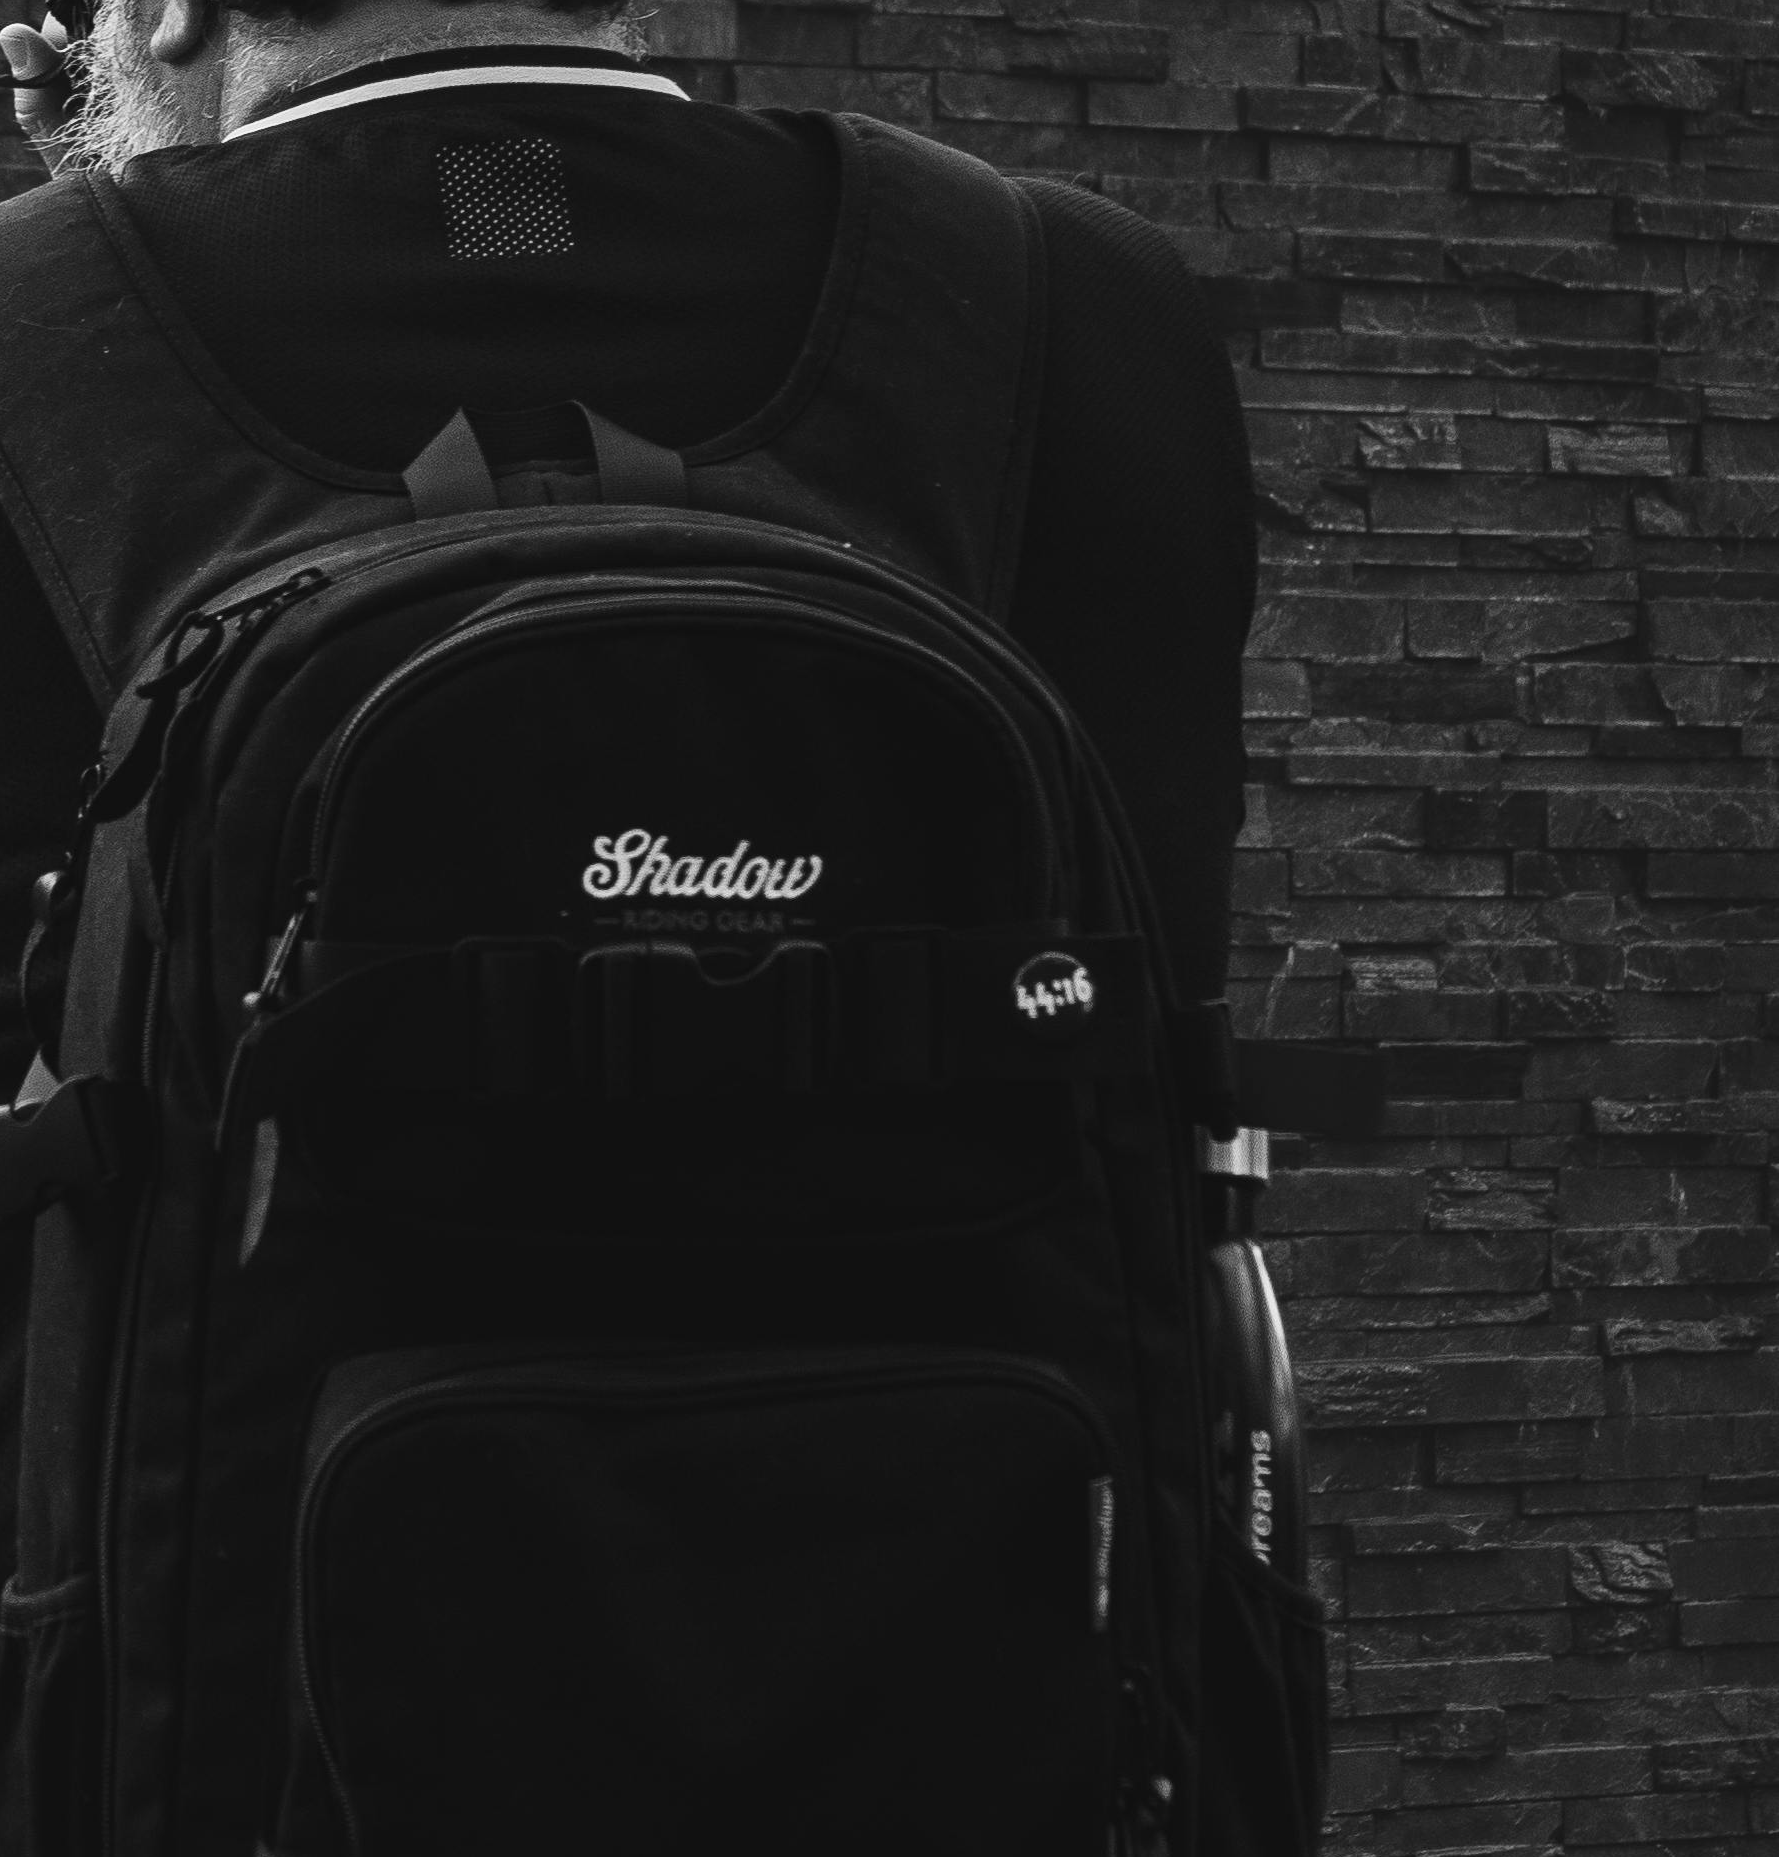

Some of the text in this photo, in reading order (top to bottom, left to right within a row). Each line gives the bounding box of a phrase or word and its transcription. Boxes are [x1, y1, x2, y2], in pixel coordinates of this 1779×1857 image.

[581, 828, 823, 900] Shadow
[621, 909, 785, 933] RIDING GEAR
